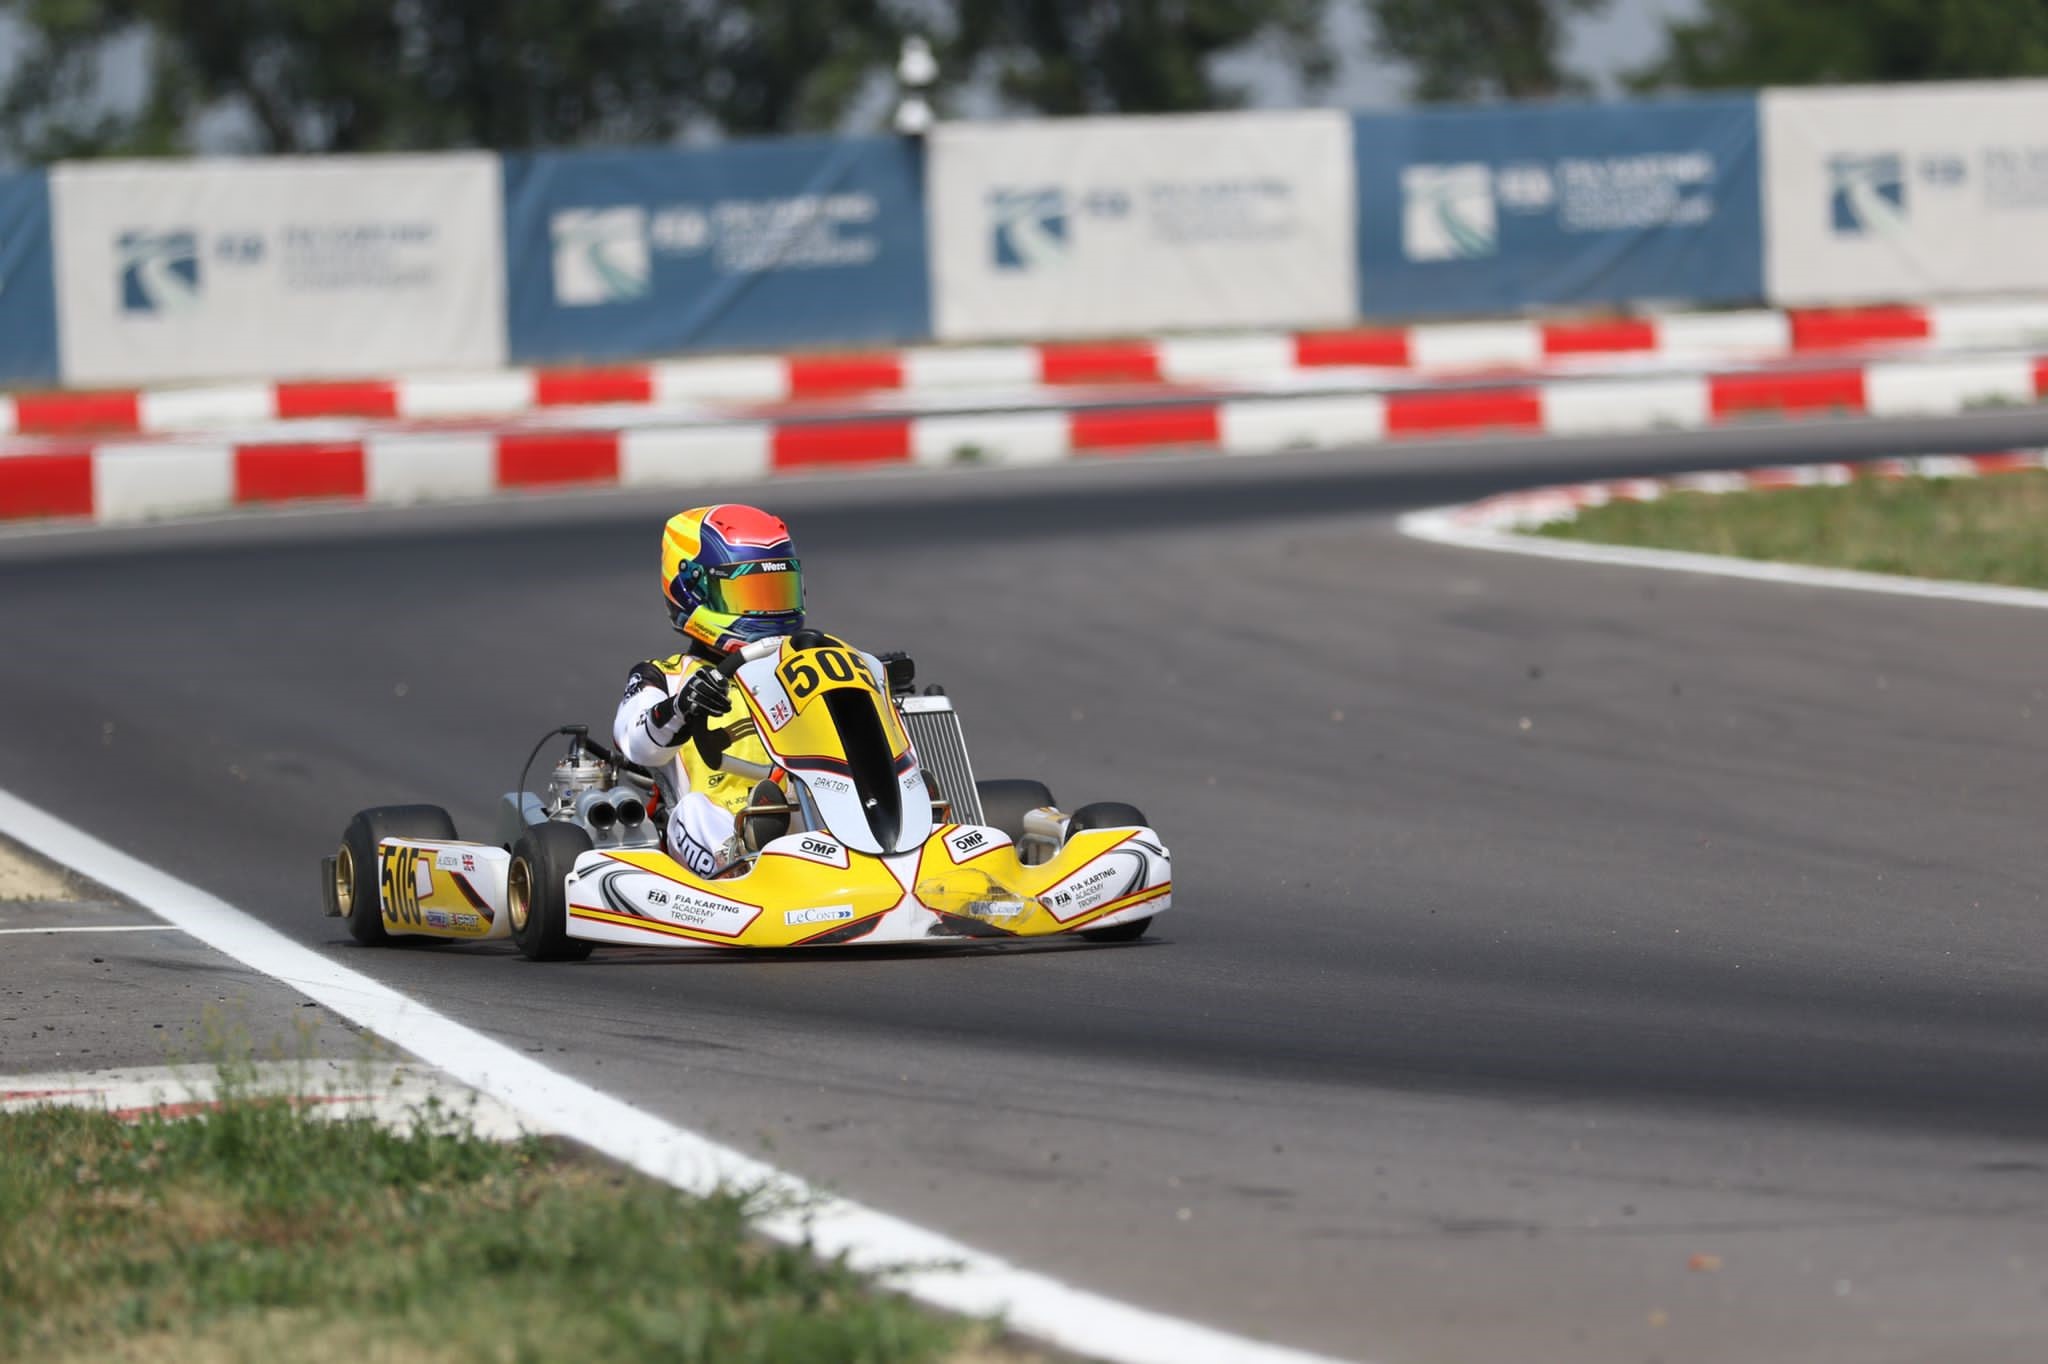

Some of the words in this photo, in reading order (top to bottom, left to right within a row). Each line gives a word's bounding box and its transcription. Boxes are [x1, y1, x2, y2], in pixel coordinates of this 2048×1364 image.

[761, 562, 787, 572] Wera
[782, 650, 880, 698] 505
[801, 840, 837, 855] OMP
[956, 833, 984, 850] OMP
[382, 846, 421, 926] 505
[1070, 883, 1083, 892] FIA
[1084, 868, 1117, 885] KARTING
[672, 903, 715, 917] ACADEMY
[675, 894, 691, 904] FIA
[694, 898, 740, 914] KARTING
[671, 910, 706, 924] TROPHY
